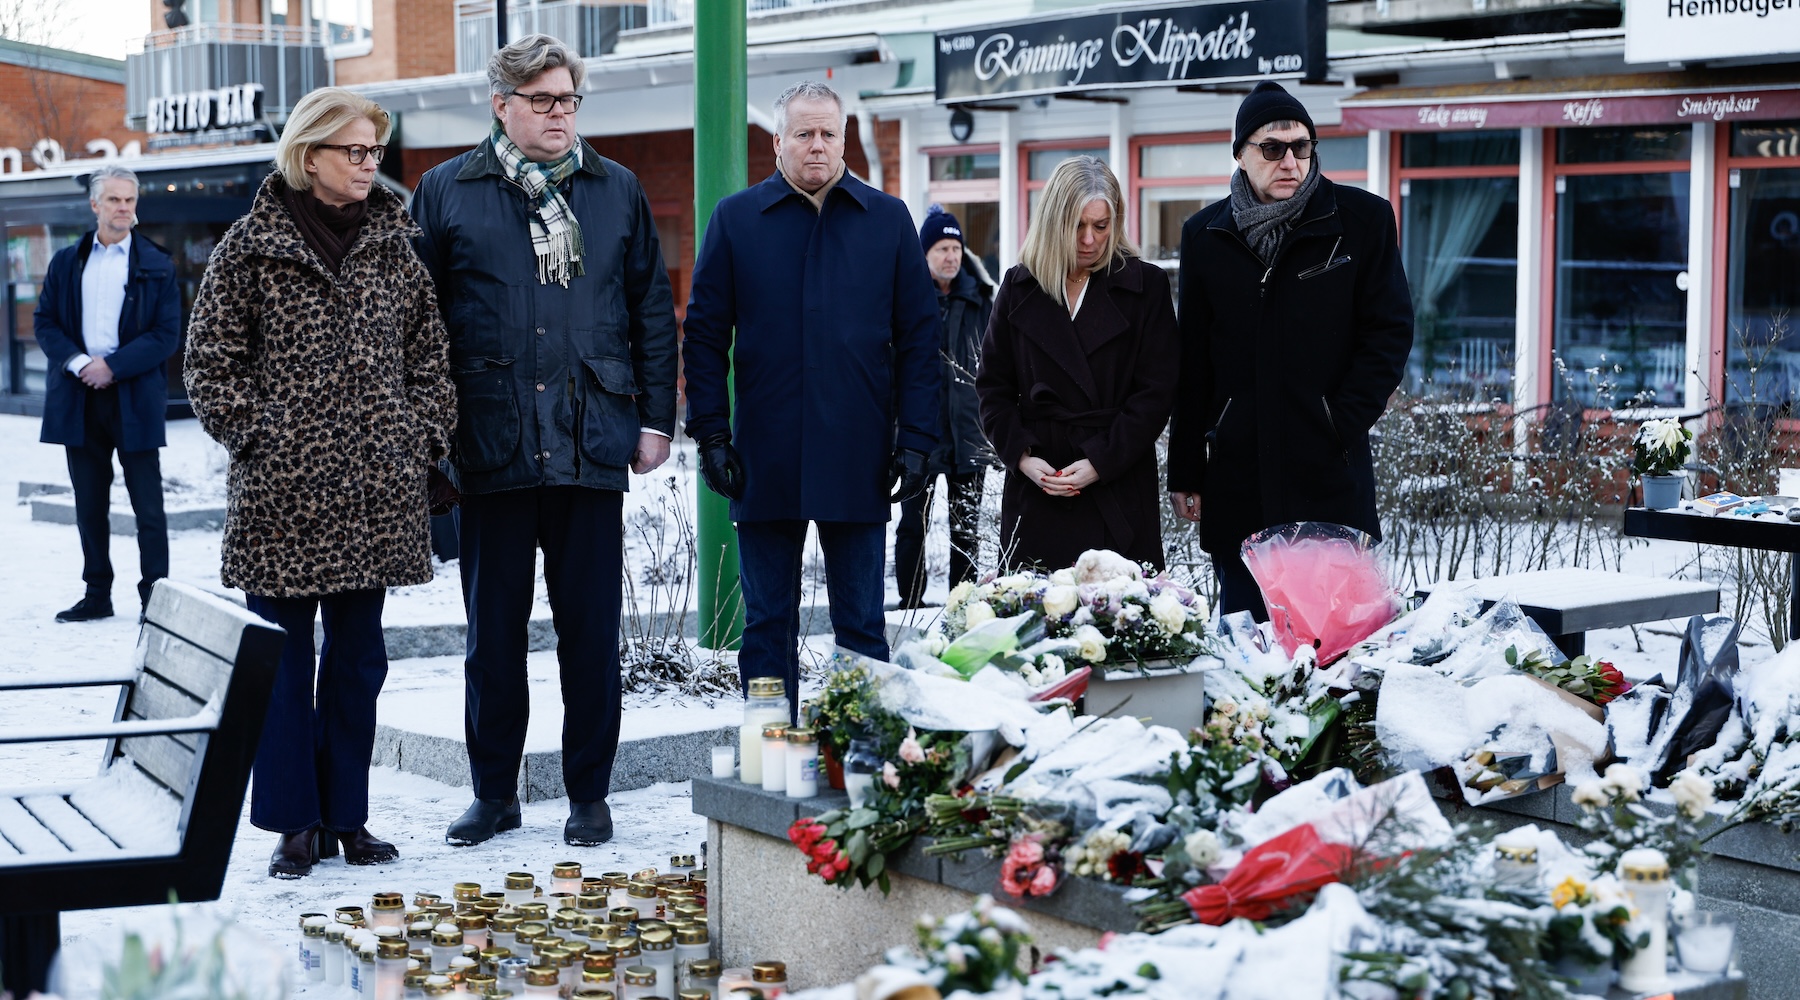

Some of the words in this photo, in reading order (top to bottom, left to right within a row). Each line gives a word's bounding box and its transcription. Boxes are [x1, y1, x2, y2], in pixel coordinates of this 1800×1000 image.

[1667, 0, 1800, 18] Hembager
[974, 33, 1104, 86] Rönninge
[1257, 55, 1272, 75] by
[1273, 54, 1302, 73] GEO
[146, 91, 211, 134] BISTRO
[217, 83, 256, 126] BAR
[1417, 103, 1450, 128] Take
[1451, 106, 1488, 128] away
[1562, 98, 1604, 126] Kaffe
[1677, 94, 1761, 121] Smörgåsar
